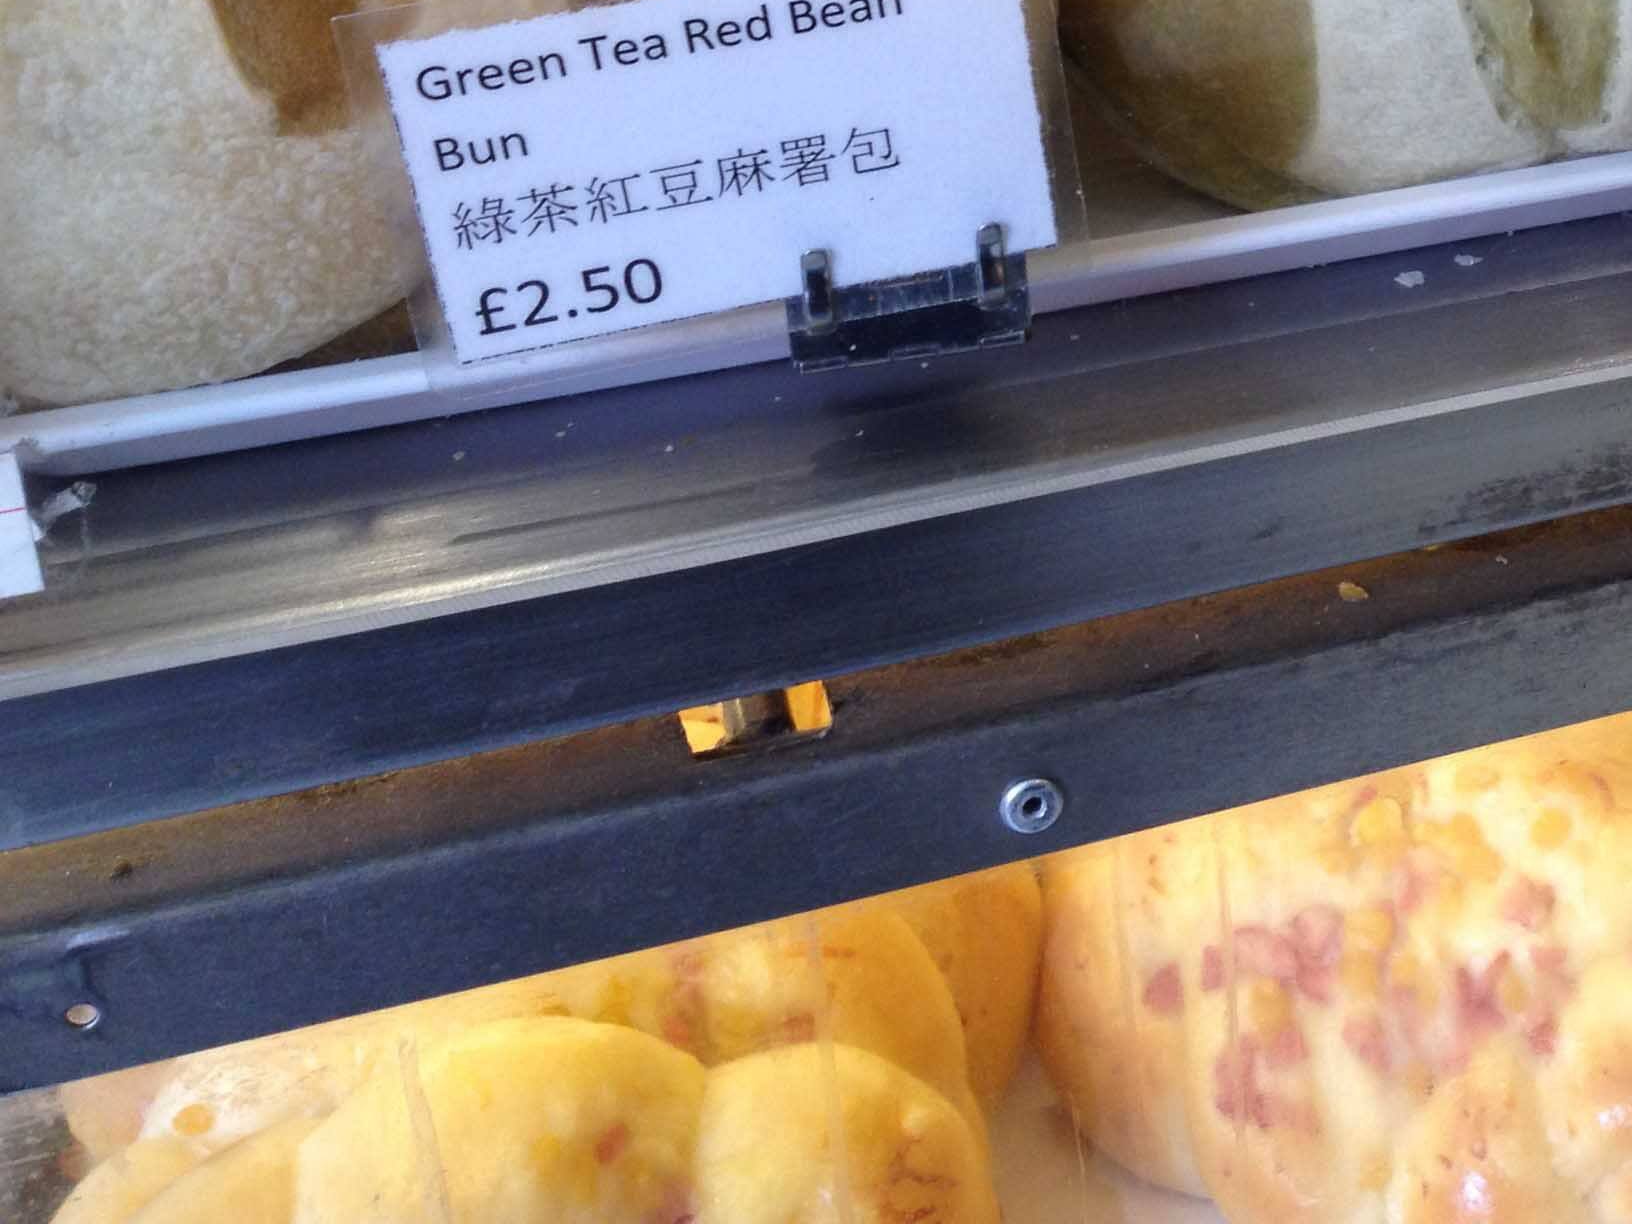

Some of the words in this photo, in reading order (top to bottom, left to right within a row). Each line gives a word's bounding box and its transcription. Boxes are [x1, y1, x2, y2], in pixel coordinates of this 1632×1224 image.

[415, 51, 569, 101] Green
[578, 31, 669, 72] Tea
[683, 3, 773, 54] Red
[432, 131, 529, 172] Bun
[452, 126, 901, 251] 綠茶紅豆麻署包
[474, 258, 664, 336] £2.50
